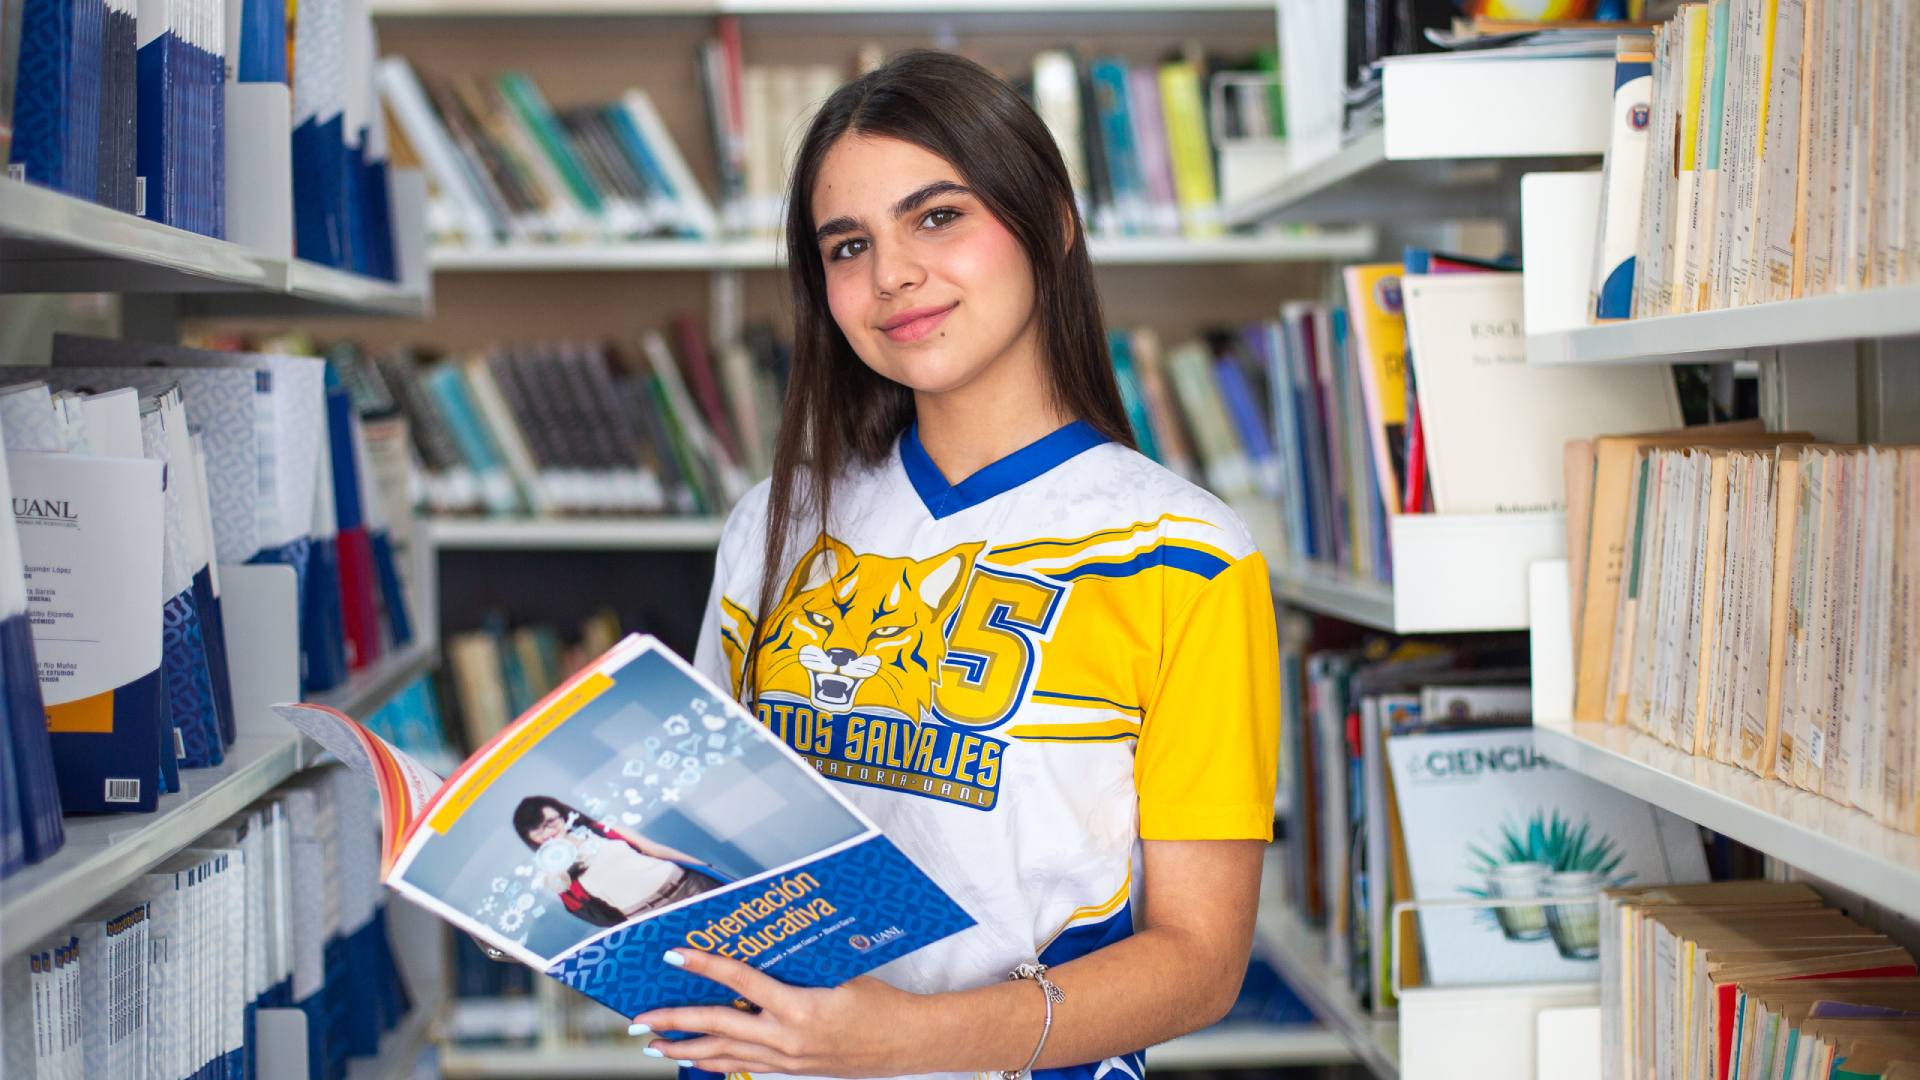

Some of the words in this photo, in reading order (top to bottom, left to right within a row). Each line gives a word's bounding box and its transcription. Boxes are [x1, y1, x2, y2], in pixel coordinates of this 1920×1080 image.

[12, 497, 79, 519] UANL
[931, 563, 1068, 731] 5
[757, 703, 834, 755] ATOS
[844, 716, 1001, 787] SALVAJES
[814, 759, 909, 787] RATORIA
[922, 778, 987, 806] UANL
[686, 871, 821, 951] Orientación
[717, 897, 838, 962] Educativa
[870, 925, 904, 944] UANL
